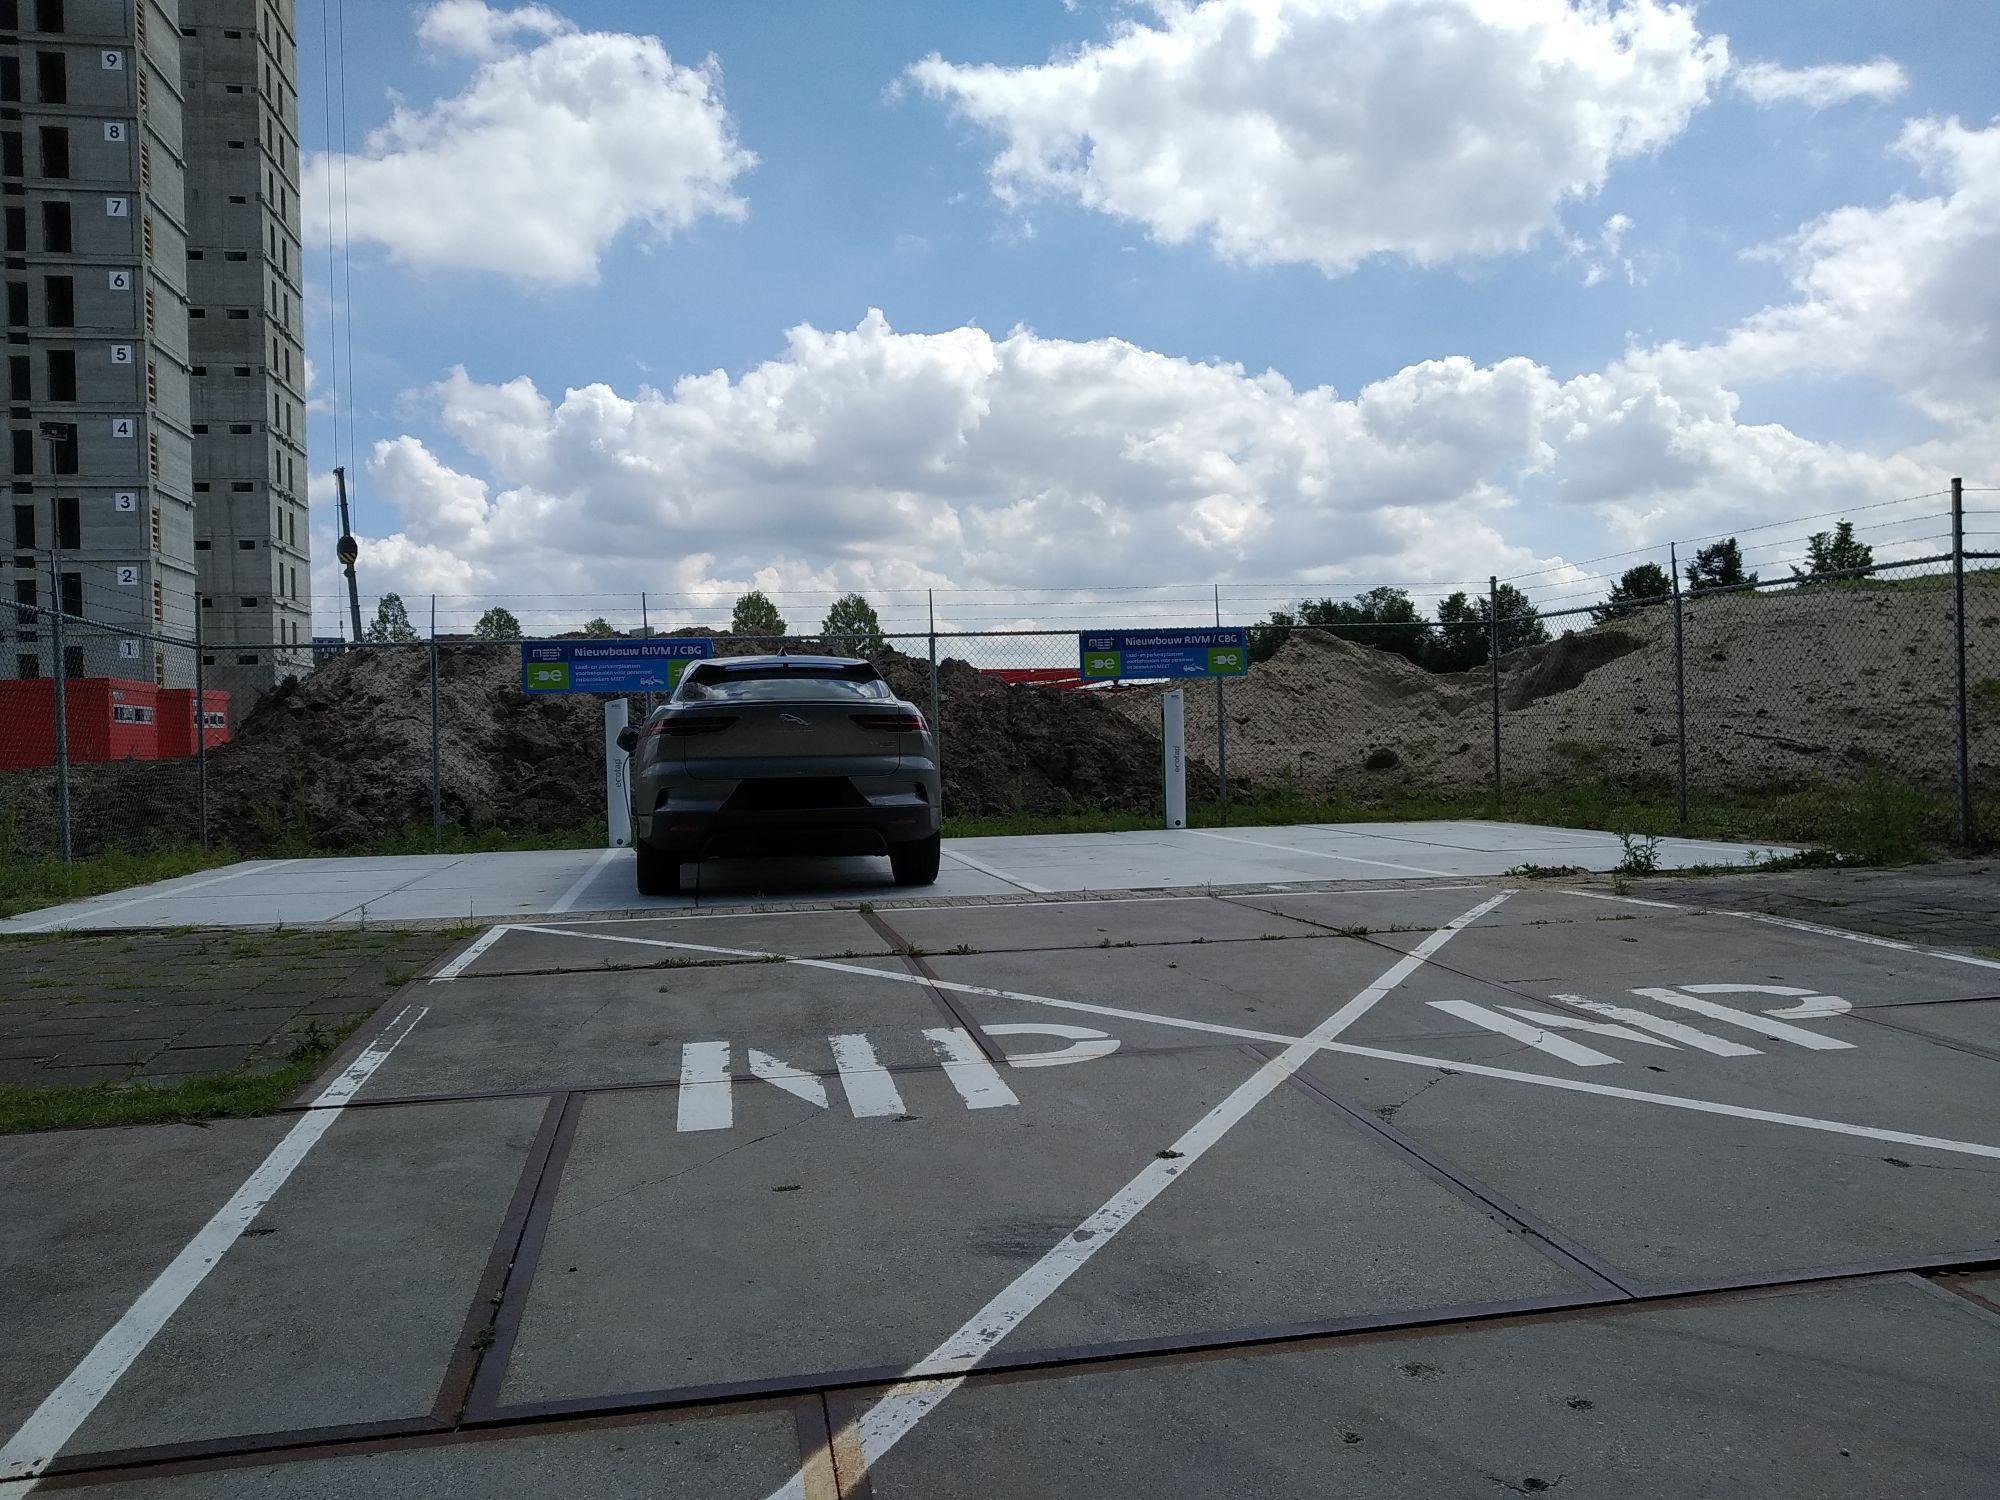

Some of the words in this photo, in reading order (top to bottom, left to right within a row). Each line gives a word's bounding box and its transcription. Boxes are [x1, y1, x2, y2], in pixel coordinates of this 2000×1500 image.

[106, 53, 117, 67] 9
[109, 125, 120, 139] 8
[112, 200, 121, 214] 7
[114, 273, 124, 288] 6
[116, 347, 127, 361] 5
[117, 421, 128, 435] 4
[120, 495, 131, 509] 3
[122, 569, 133, 583] 2
[1125, 637, 1182, 646] Nieuwbouw
[1185, 635, 1210, 645] RIVM
[1218, 634, 1238, 643] CBG
[125, 641, 133, 655] 1
[574, 647, 639, 657] Nieuwbouw
[643, 645, 671, 656] RIVM
[680, 645, 702, 655] CBG
[1173, 746, 1181, 772] ecotap
[615, 759, 623, 787] ecotap
